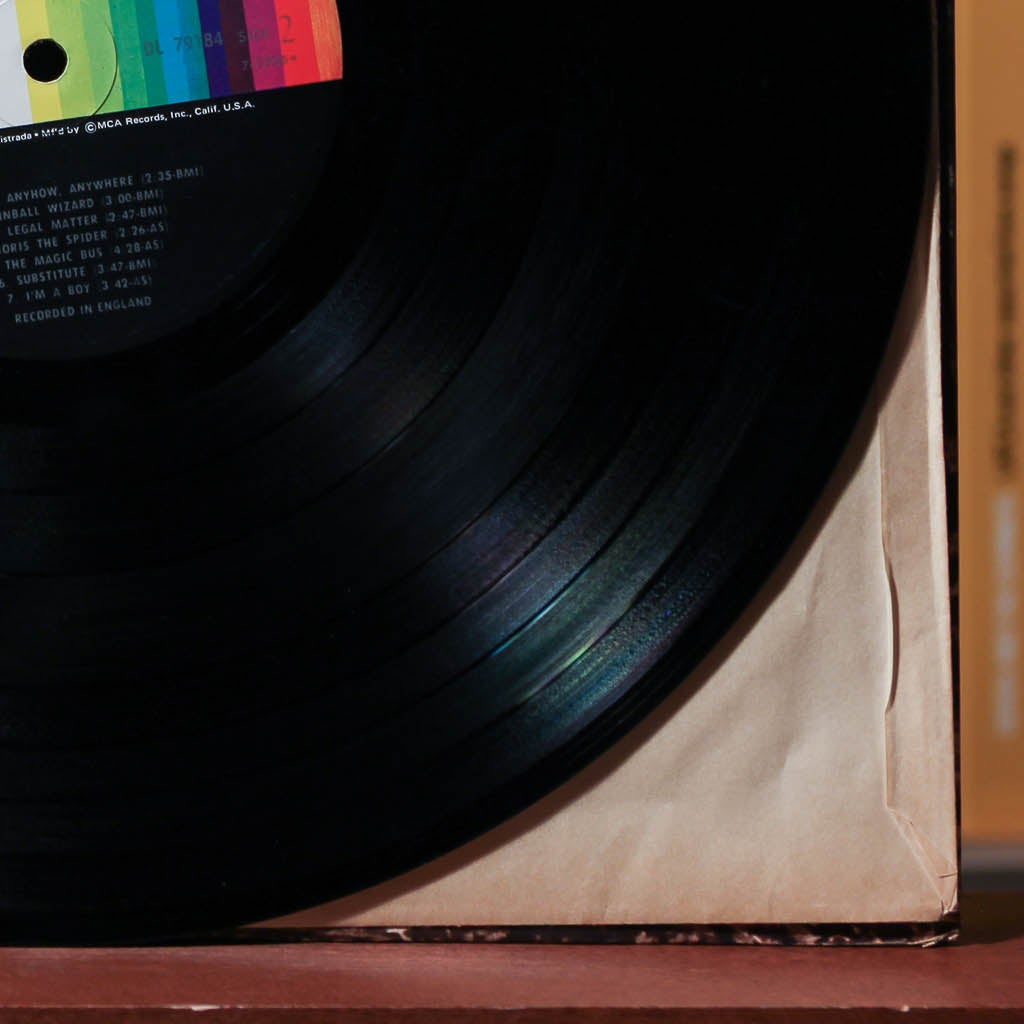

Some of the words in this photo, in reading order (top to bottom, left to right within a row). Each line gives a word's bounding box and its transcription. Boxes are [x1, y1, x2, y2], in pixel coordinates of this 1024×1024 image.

[143, 39, 164, 57] DL
[125, 112, 168, 126] Records,
[194, 104, 220, 116] Calif.
[223, 99, 256, 113] U.S.A.
[69, 175, 134, 194] ANYWHERE
[47, 198, 95, 214] WIZARD
[7, 222, 44, 237] LEGAL
[51, 214, 98, 231] MATTER
[37, 236, 59, 250] THE
[65, 230, 108, 246] SPIDER
[5, 257, 27, 271] THE
[34, 251, 73, 267] MAGIC
[80, 247, 103, 261] BUS
[16, 266, 87, 286] SUBSTITUTE
[25, 288, 46, 302] I'M
[52, 287, 61, 298] A
[68, 283, 91, 297] BOY
[15, 305, 75, 324] RECORDED
[80, 303, 93, 315] IN
[97, 295, 152, 314] ENGLAND
